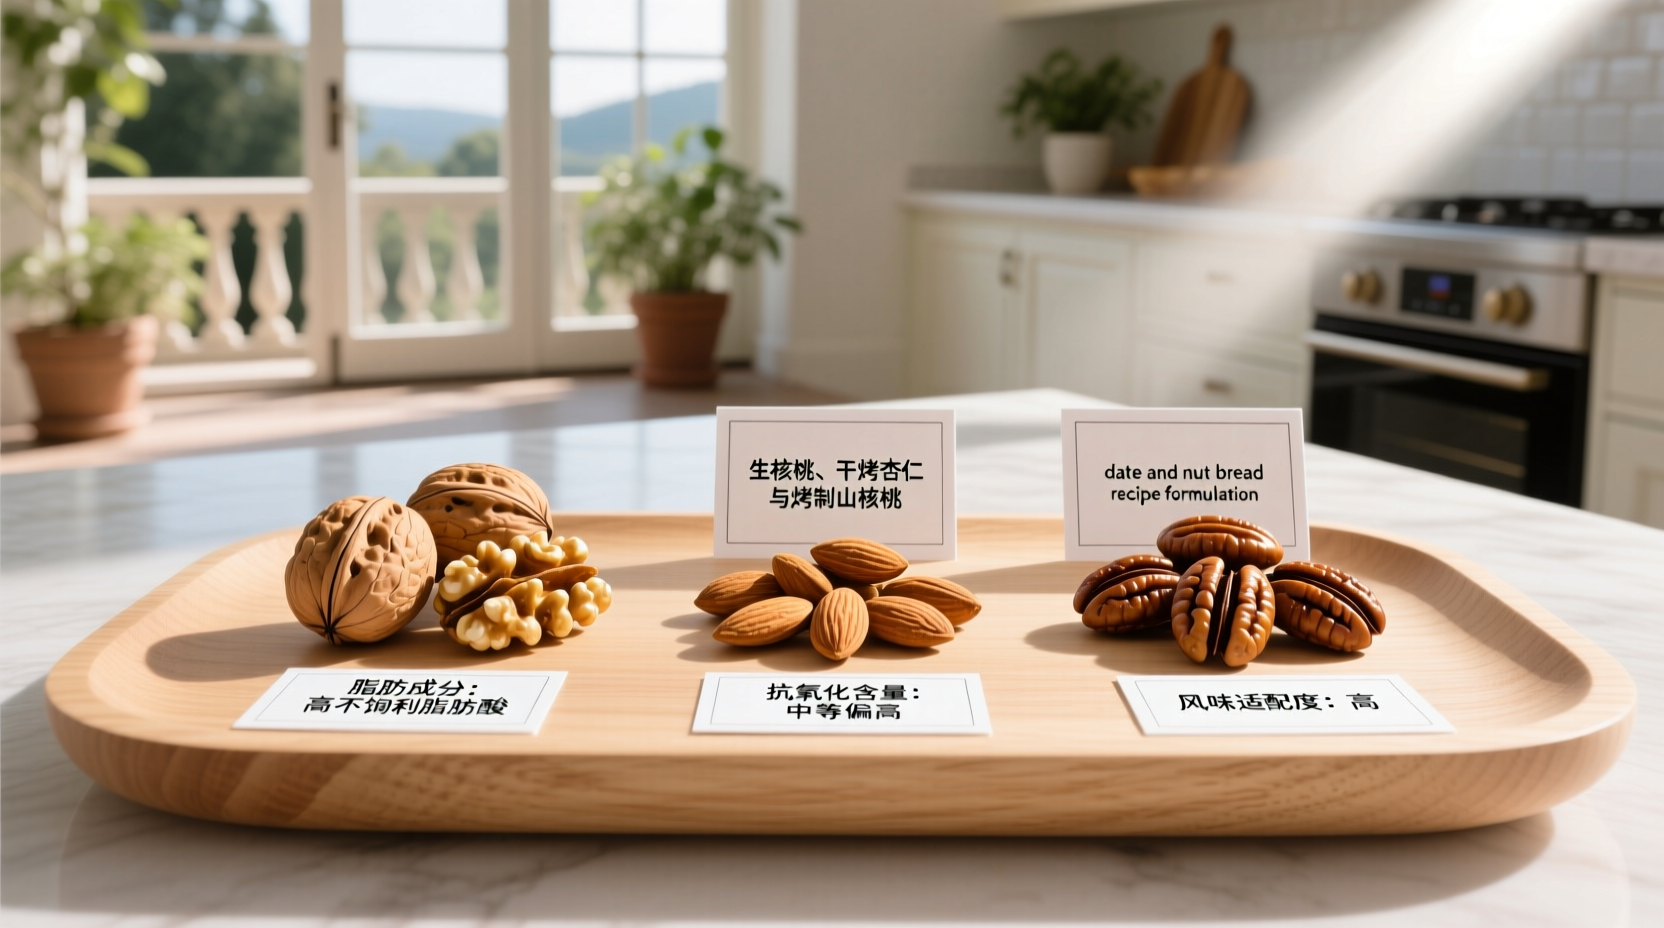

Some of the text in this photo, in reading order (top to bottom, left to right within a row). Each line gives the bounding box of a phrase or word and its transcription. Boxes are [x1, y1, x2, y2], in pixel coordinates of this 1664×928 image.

[749, 458, 924, 481] 生核桃、干烤杏仁
[1104, 464, 1264, 480] date and nut bread
[769, 486, 902, 509] 与烤制山核桃
[1111, 485, 1259, 505] recipe formulation
[786, 703, 901, 720] 中等偏高
